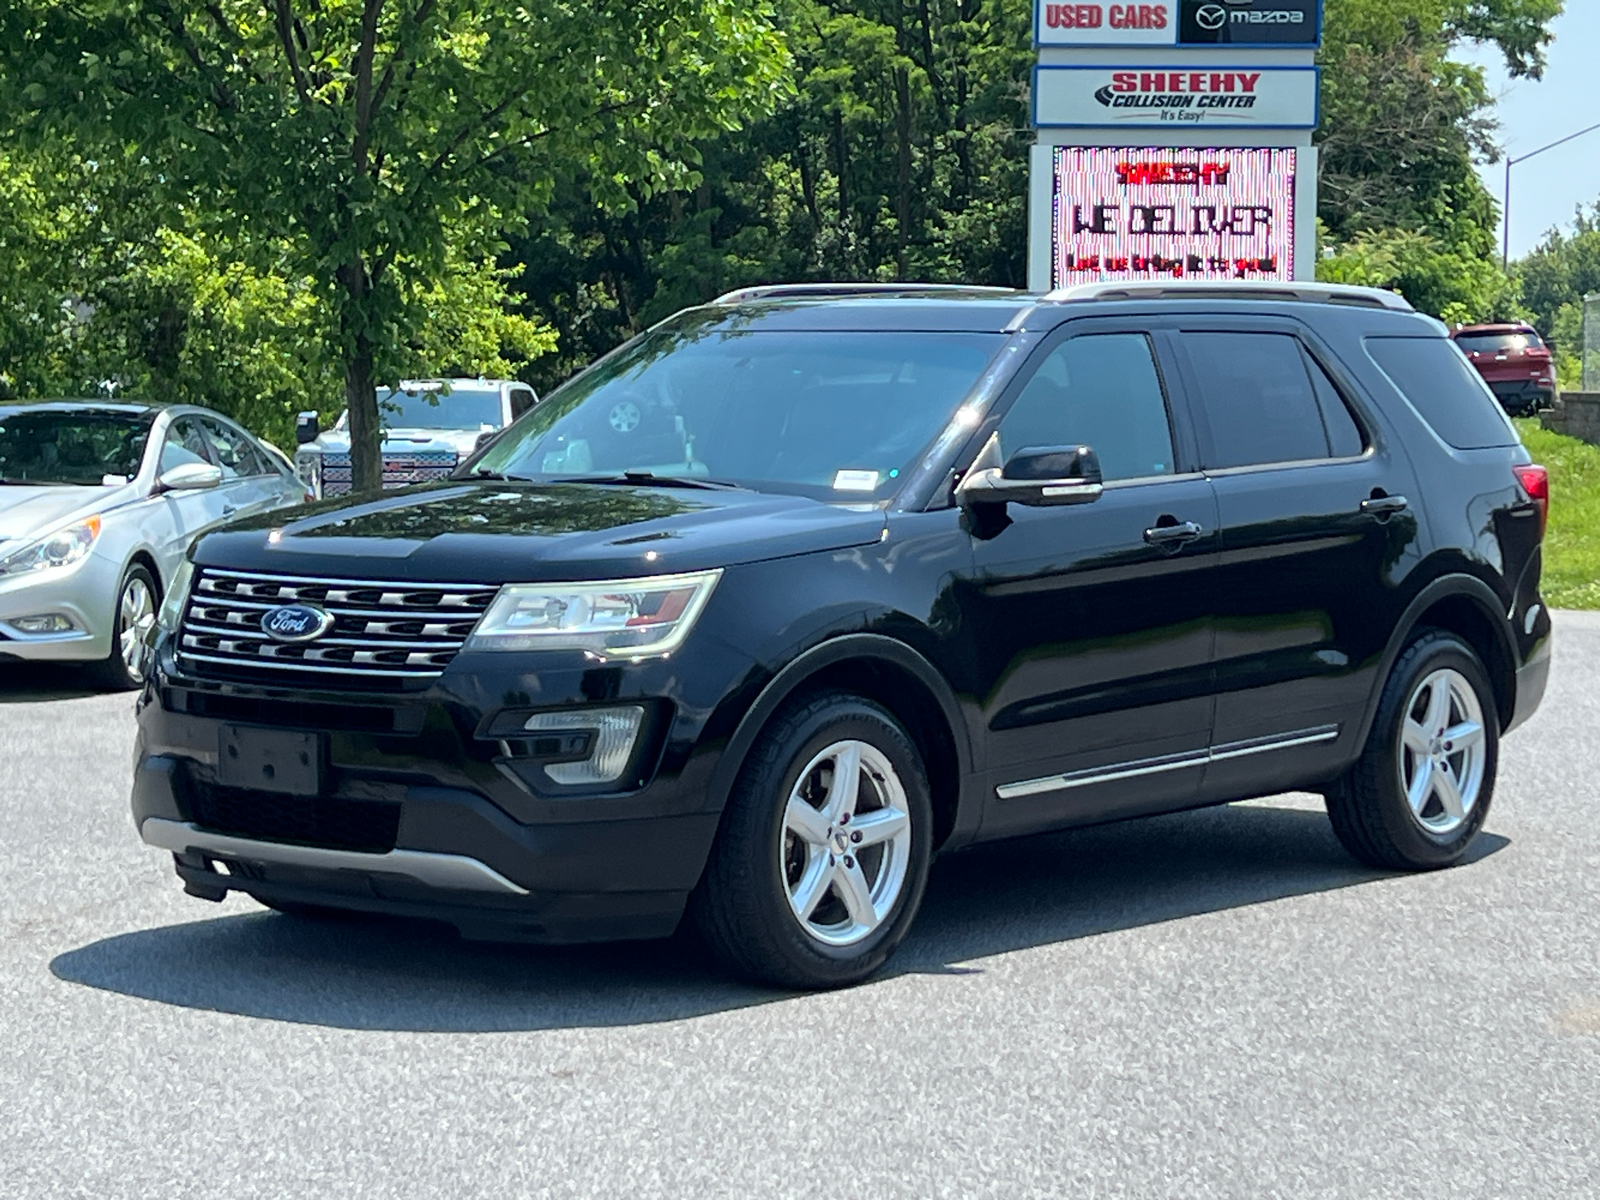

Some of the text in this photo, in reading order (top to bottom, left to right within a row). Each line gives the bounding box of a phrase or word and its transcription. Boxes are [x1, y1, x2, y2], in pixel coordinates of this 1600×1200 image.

[1046, 4, 1168, 30] USED CARS
[1230, 10, 1304, 24] mazda
[1112, 72, 1261, 93] SHEEHY
[1112, 95, 1257, 108] COLLISION CENTER
[1160, 109, 1206, 123] It's Easy!
[1073, 204, 1273, 235] WE DELIVER
[270, 608, 309, 632] Ford
